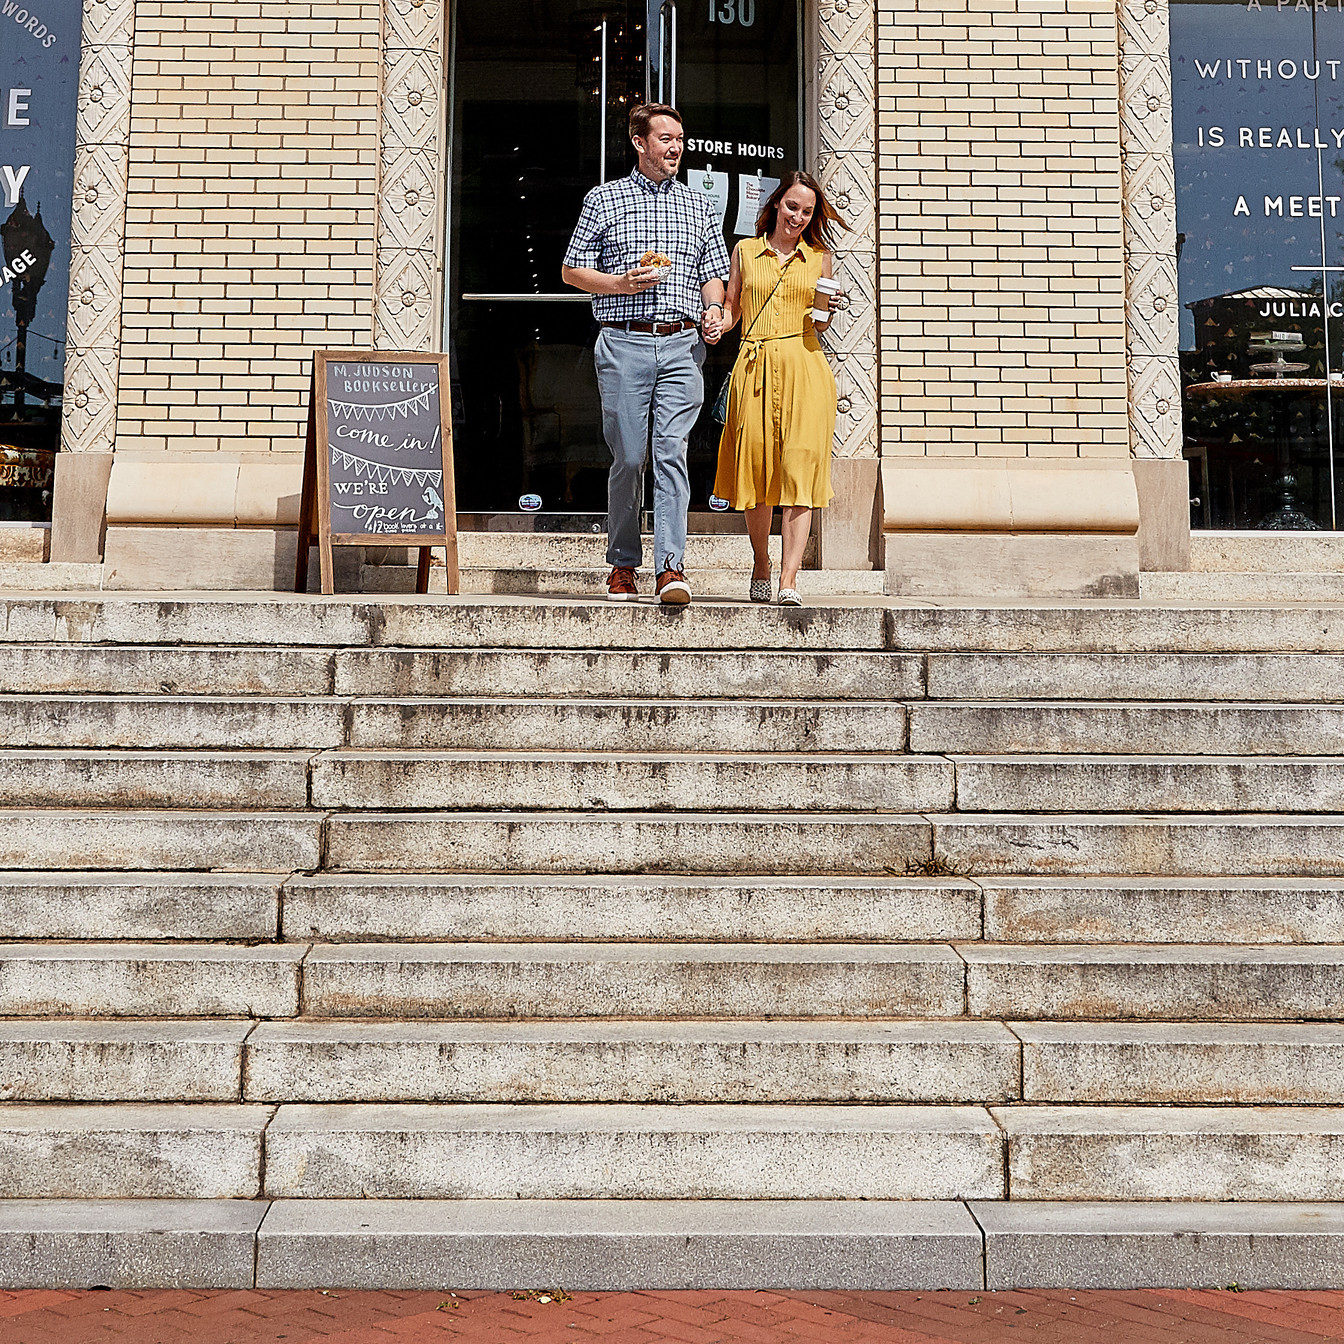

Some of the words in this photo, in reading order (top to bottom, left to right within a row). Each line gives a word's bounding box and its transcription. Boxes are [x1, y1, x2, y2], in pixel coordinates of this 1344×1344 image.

[1, 0, 57, 49] WORDS
[1194, 59, 1342, 81] WITHOUT
[1197, 126, 1225, 148] IS
[687, 138, 733, 155] STORE
[737, 142, 785, 160] HOURS
[1233, 195, 1251, 217] A
[1259, 301, 1321, 317] JULIA
[333, 364, 351, 377] M.
[353, 364, 413, 379] JUDSON
[336, 424, 394, 447] come
[333, 479, 389, 495] WE'RE
[333, 501, 428, 529] open
